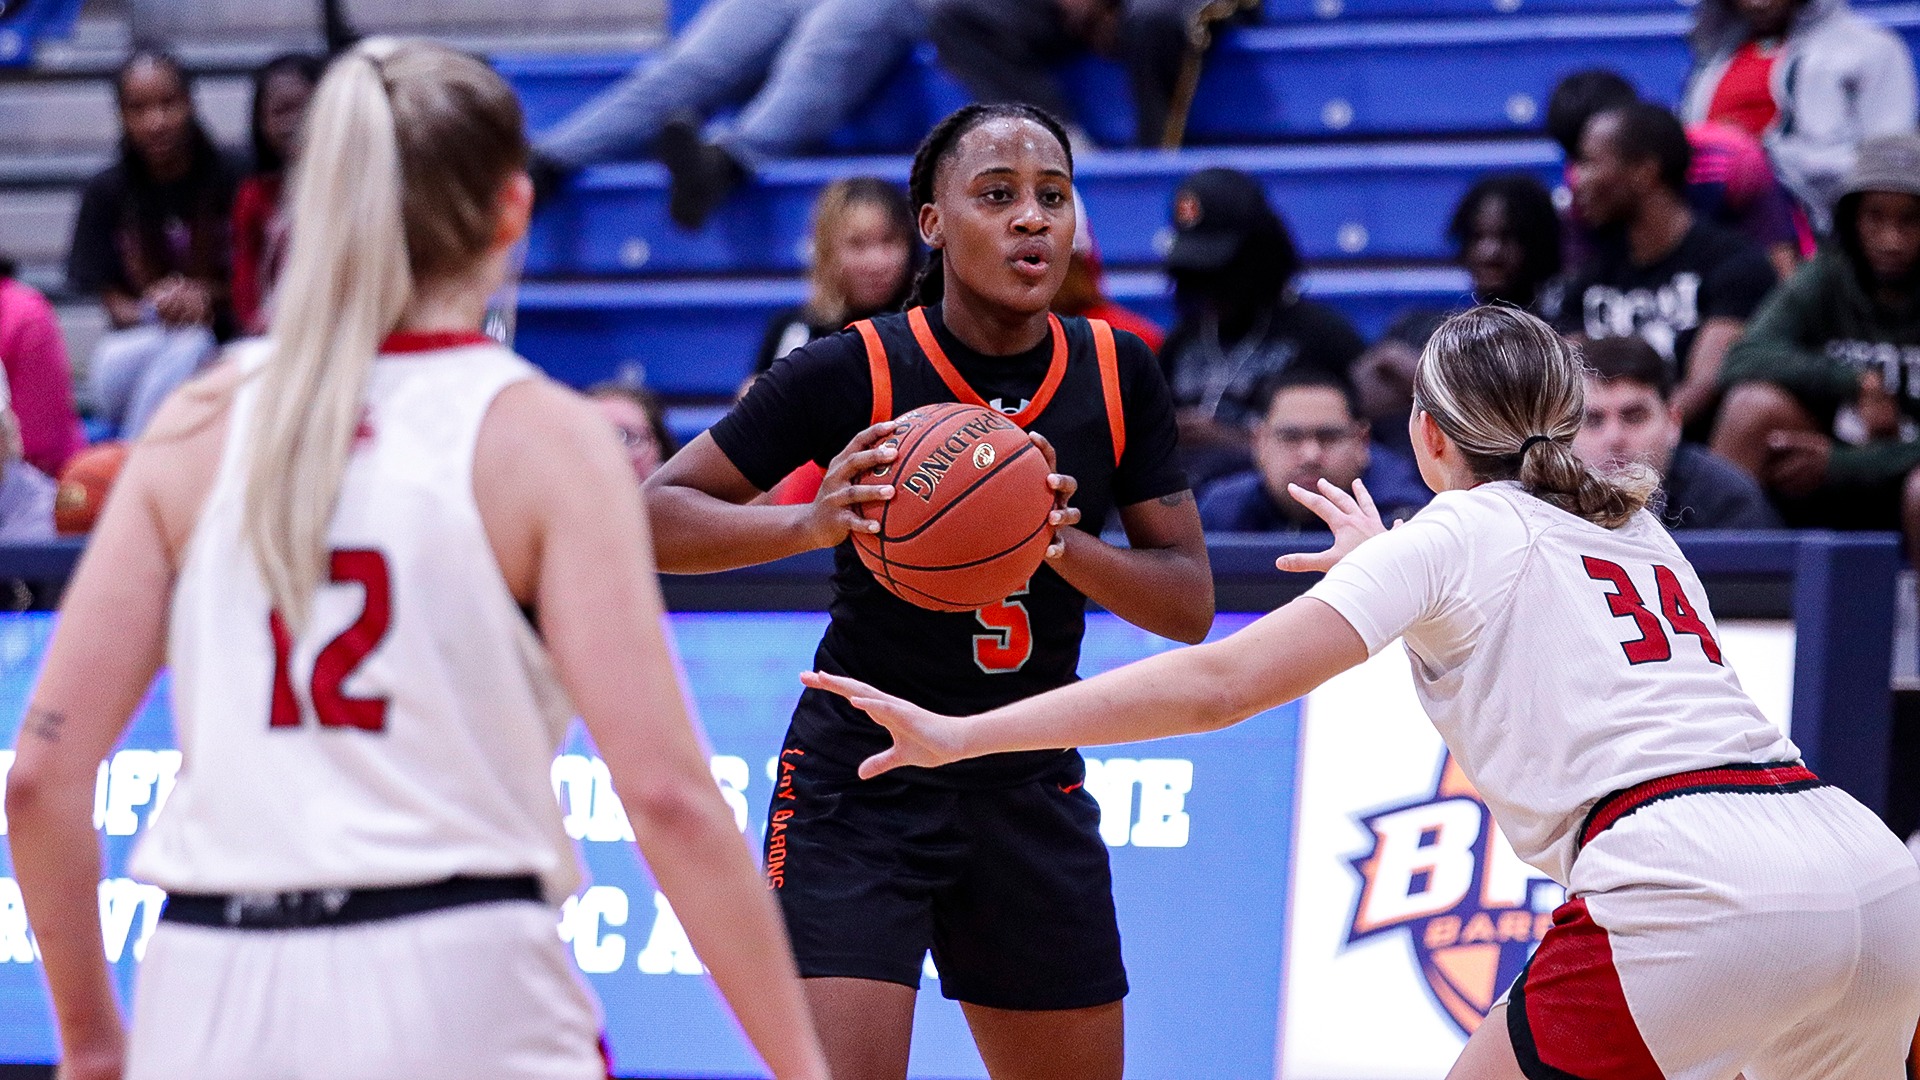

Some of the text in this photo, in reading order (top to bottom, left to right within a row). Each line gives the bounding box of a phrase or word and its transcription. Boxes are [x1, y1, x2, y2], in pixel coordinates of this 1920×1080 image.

[268, 547, 391, 732] 12
[972, 578, 1033, 674] 5
[1579, 554, 1725, 668] 34
[766, 808, 795, 891] BARONS
